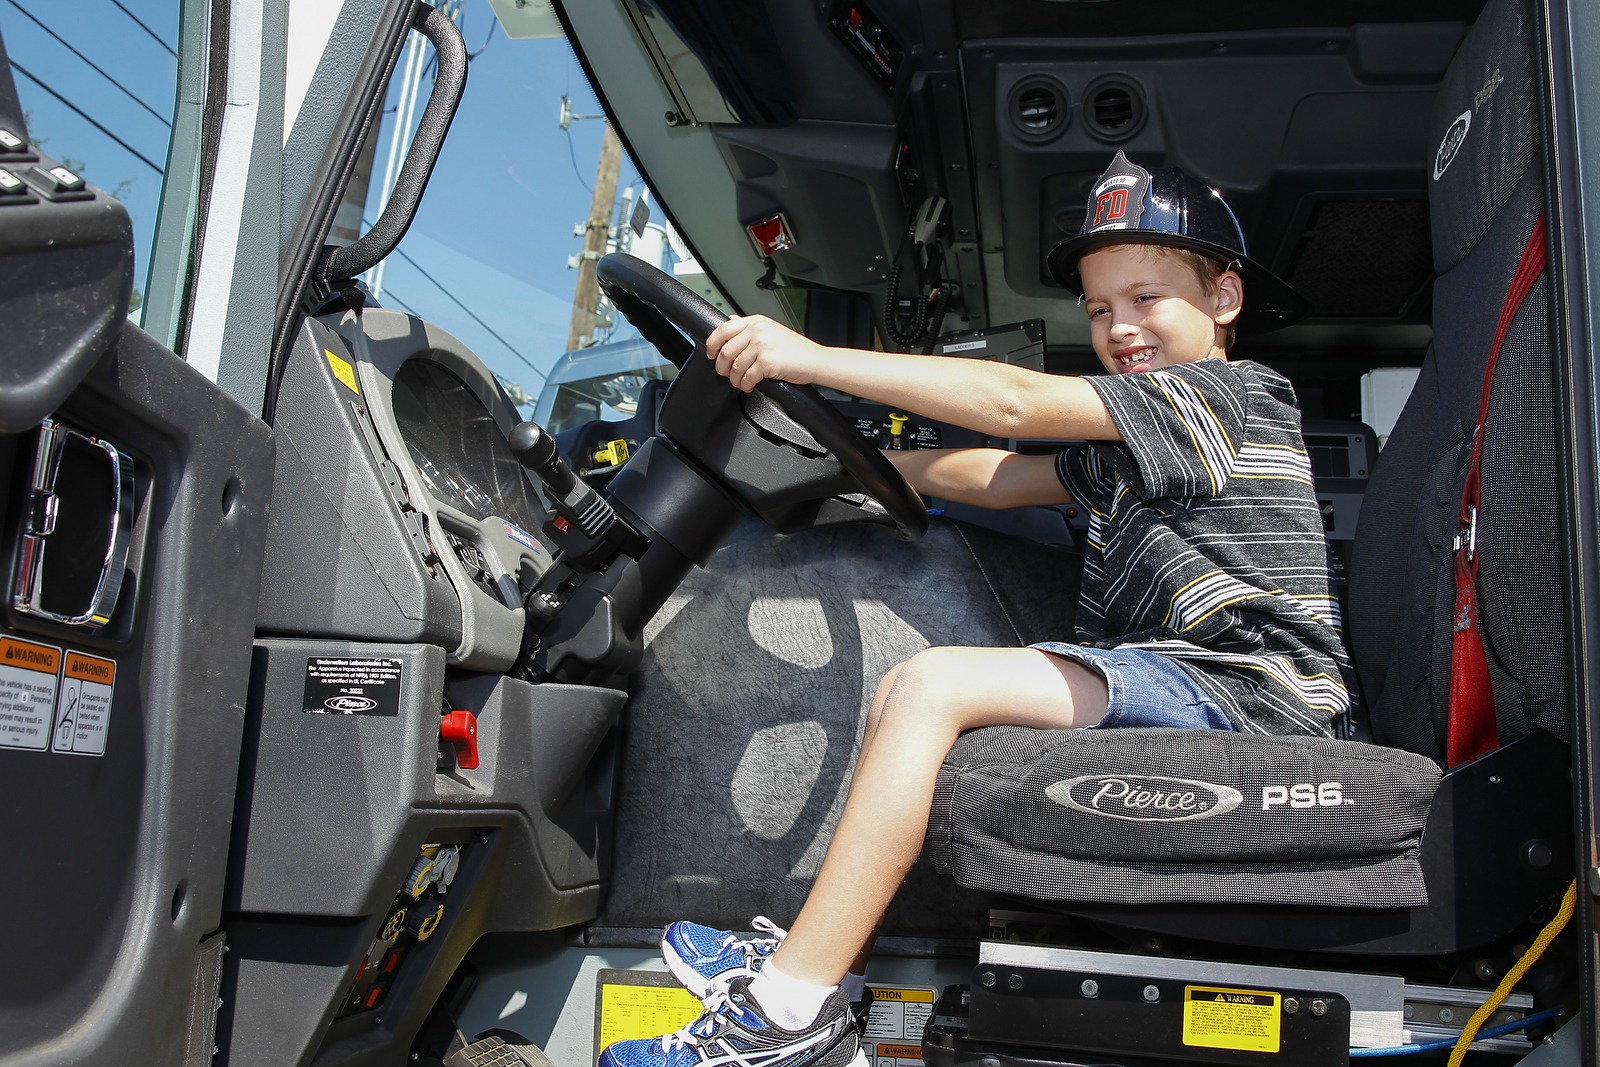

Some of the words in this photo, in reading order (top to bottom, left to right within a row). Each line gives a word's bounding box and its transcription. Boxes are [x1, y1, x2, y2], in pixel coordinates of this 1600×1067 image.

[1093, 188, 1128, 226] FD
[14, 648, 53, 666] WARNING
[78, 661, 109, 678] WARNING
[1092, 778, 1197, 811] Pierce
[1262, 782, 1343, 810] PS6
[874, 990, 902, 1000] UTION
[1226, 994, 1254, 1004] WARNING
